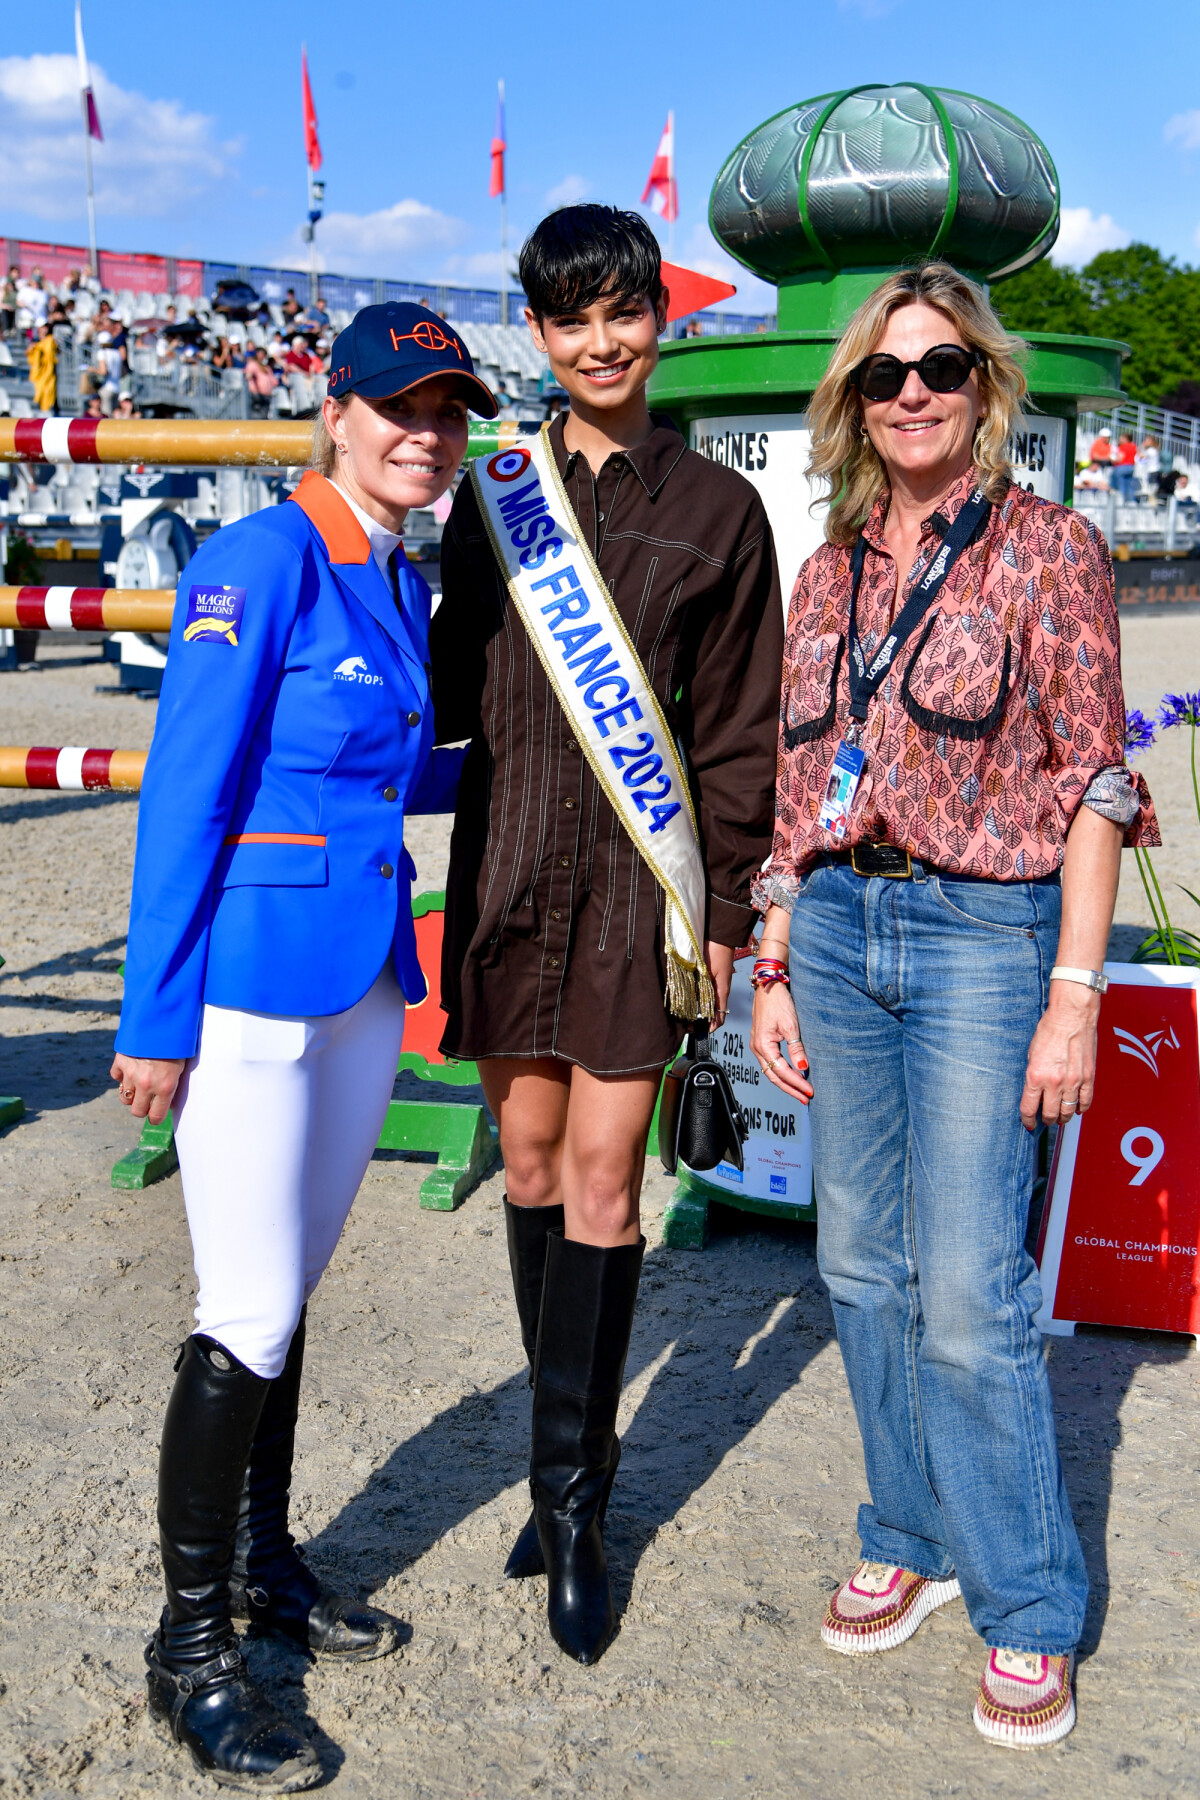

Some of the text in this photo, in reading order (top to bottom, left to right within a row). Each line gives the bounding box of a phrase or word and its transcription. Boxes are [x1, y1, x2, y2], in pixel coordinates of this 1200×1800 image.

[920, 544, 952, 591] LONGINES
[195, 604, 234, 615] MILLIONS
[196, 593, 237, 608] MAGIC
[496, 478, 682, 834] MISS FRANCE 2024
[865, 634, 898, 681] LONGINES
[333, 673, 384, 686] STAL TOPS
[722, 1031, 744, 1059] 2024
[764, 1110, 796, 1138] TOUR
[774, 1160, 802, 1169] CHAMPIONS
[1120, 1126, 1165, 1186] 9
[1074, 1235, 1198, 1256] GLOBAL CHAMPIONS
[1116, 1252, 1154, 1262] LEAGUE
